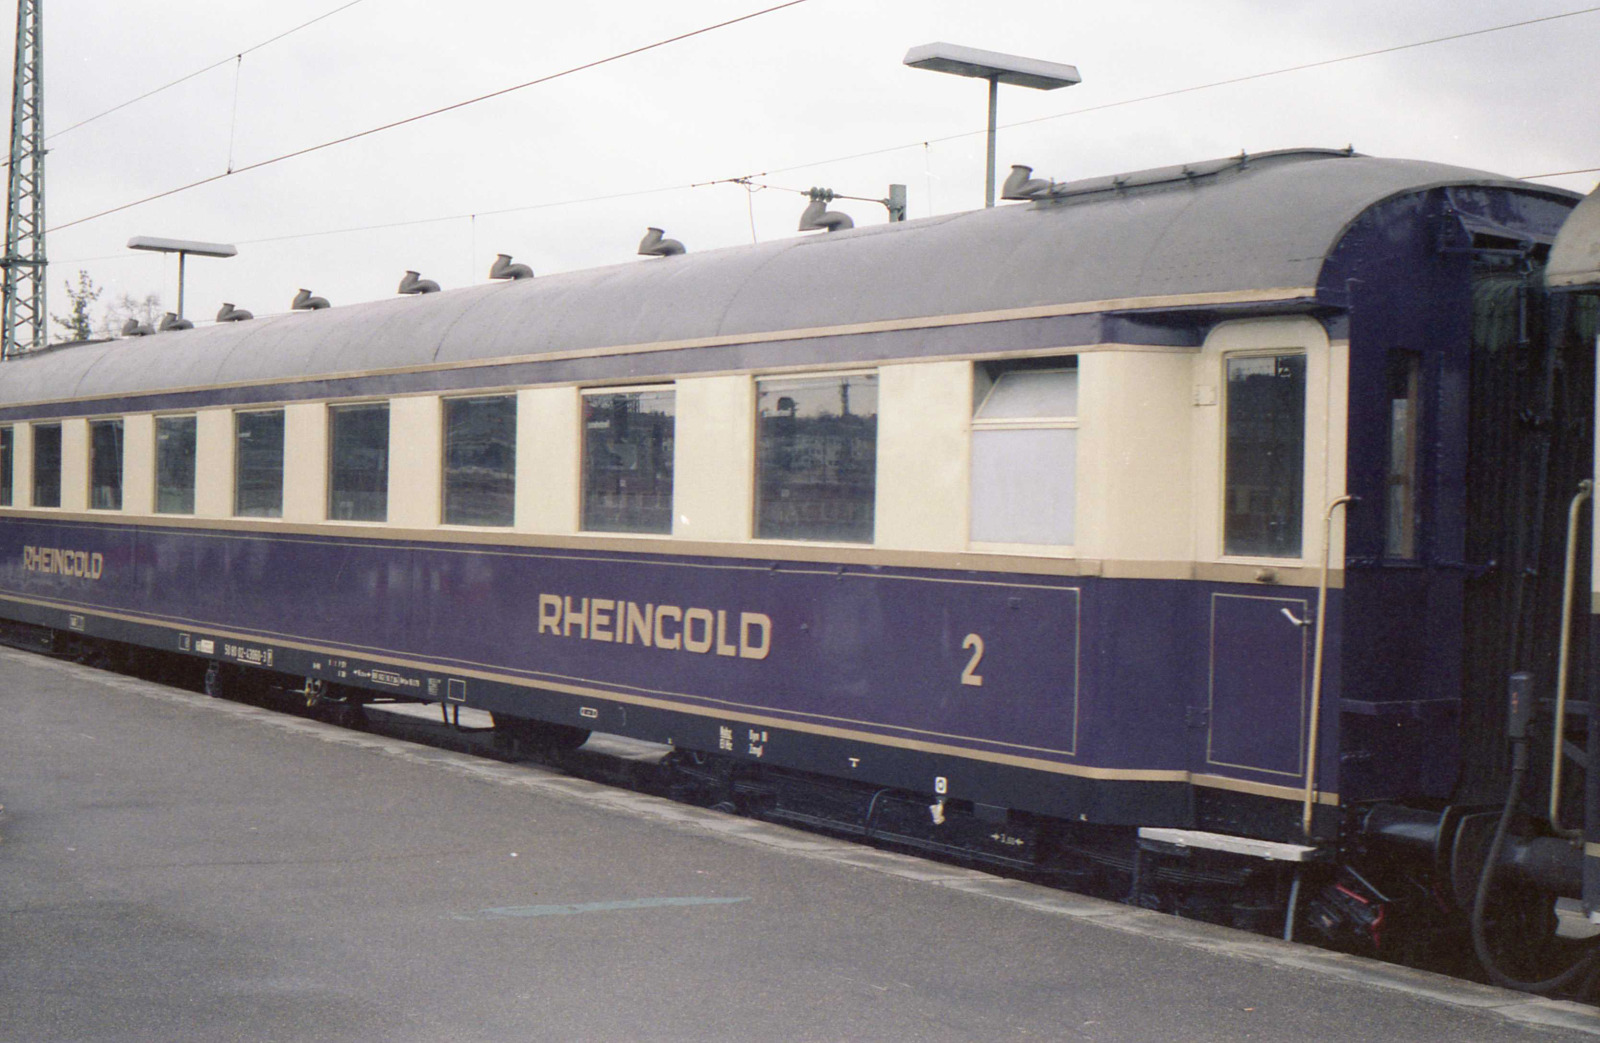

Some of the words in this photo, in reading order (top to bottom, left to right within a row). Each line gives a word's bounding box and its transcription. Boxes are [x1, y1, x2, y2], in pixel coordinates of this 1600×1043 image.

[23, 545, 103, 580] RHEINGOLD
[538, 593, 772, 660] RHEINGOLD
[961, 633, 984, 686] 2
